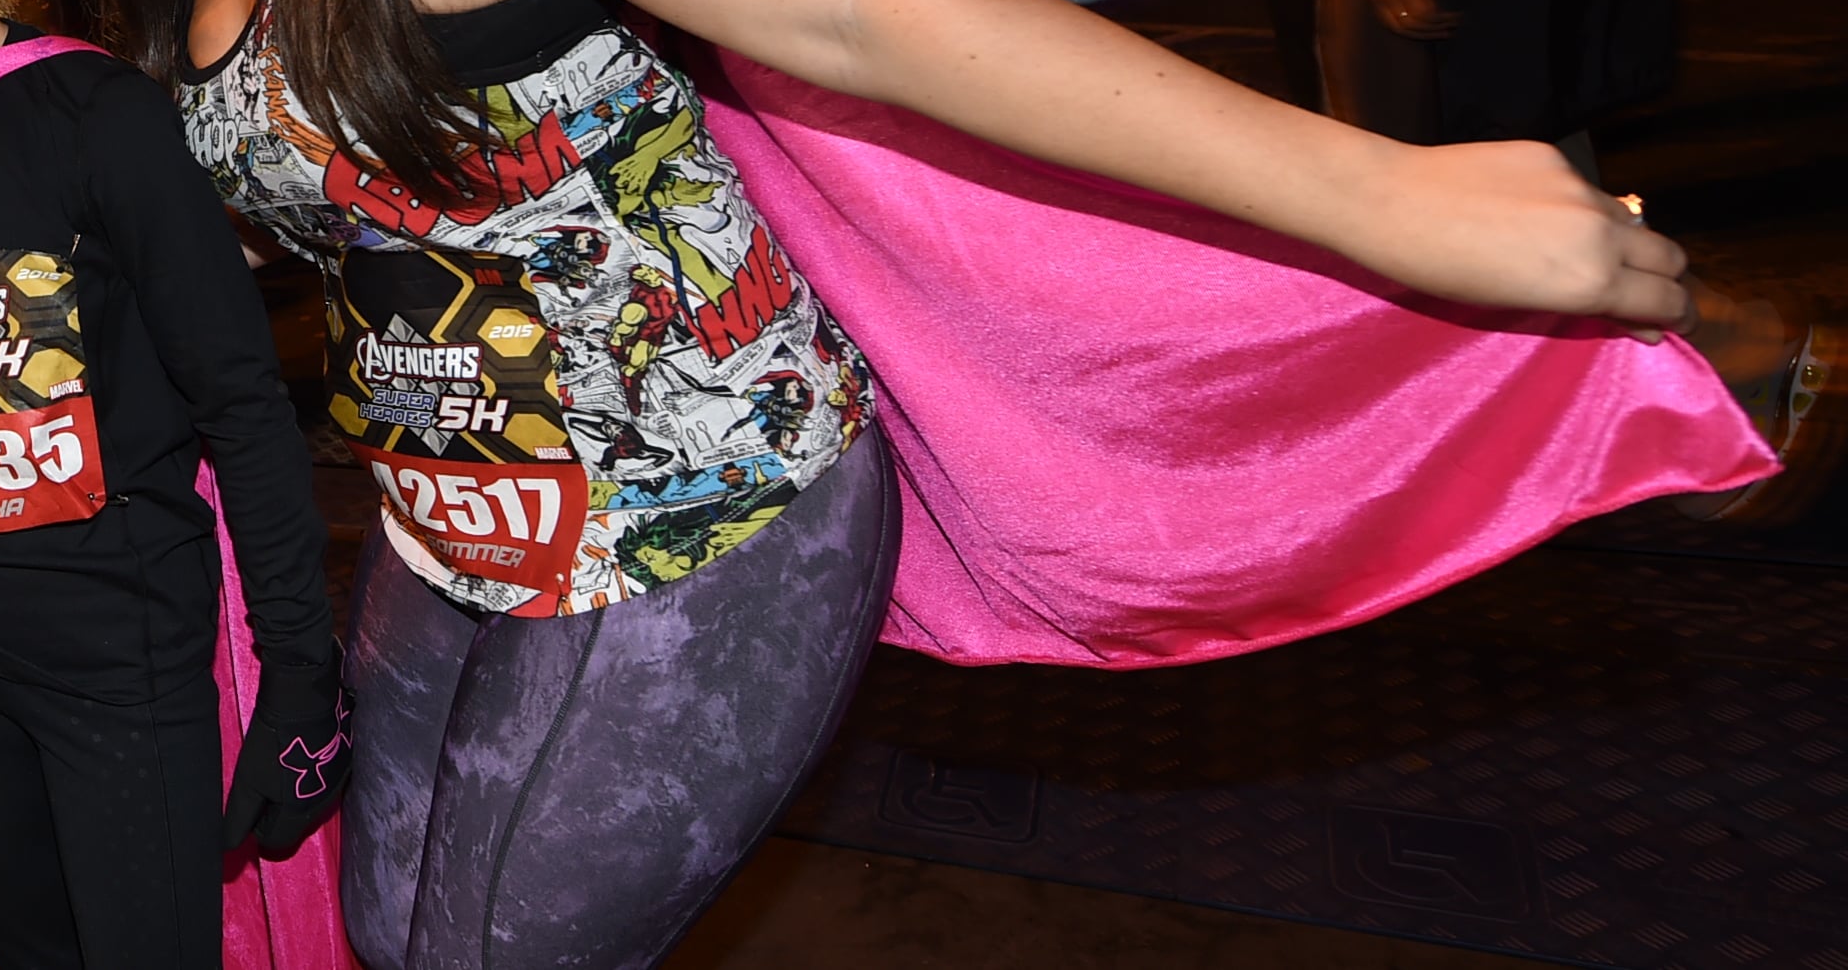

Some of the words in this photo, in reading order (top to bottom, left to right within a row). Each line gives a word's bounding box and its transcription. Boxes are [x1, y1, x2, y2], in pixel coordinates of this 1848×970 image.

[14, 267, 64, 281] 2015
[487, 323, 536, 340] 2015
[355, 331, 481, 381] AVENGERS
[50, 379, 85, 401] MARVEL
[359, 403, 434, 429] HEROES
[372, 388, 435, 411] SUPER
[437, 396, 510, 433] 5K
